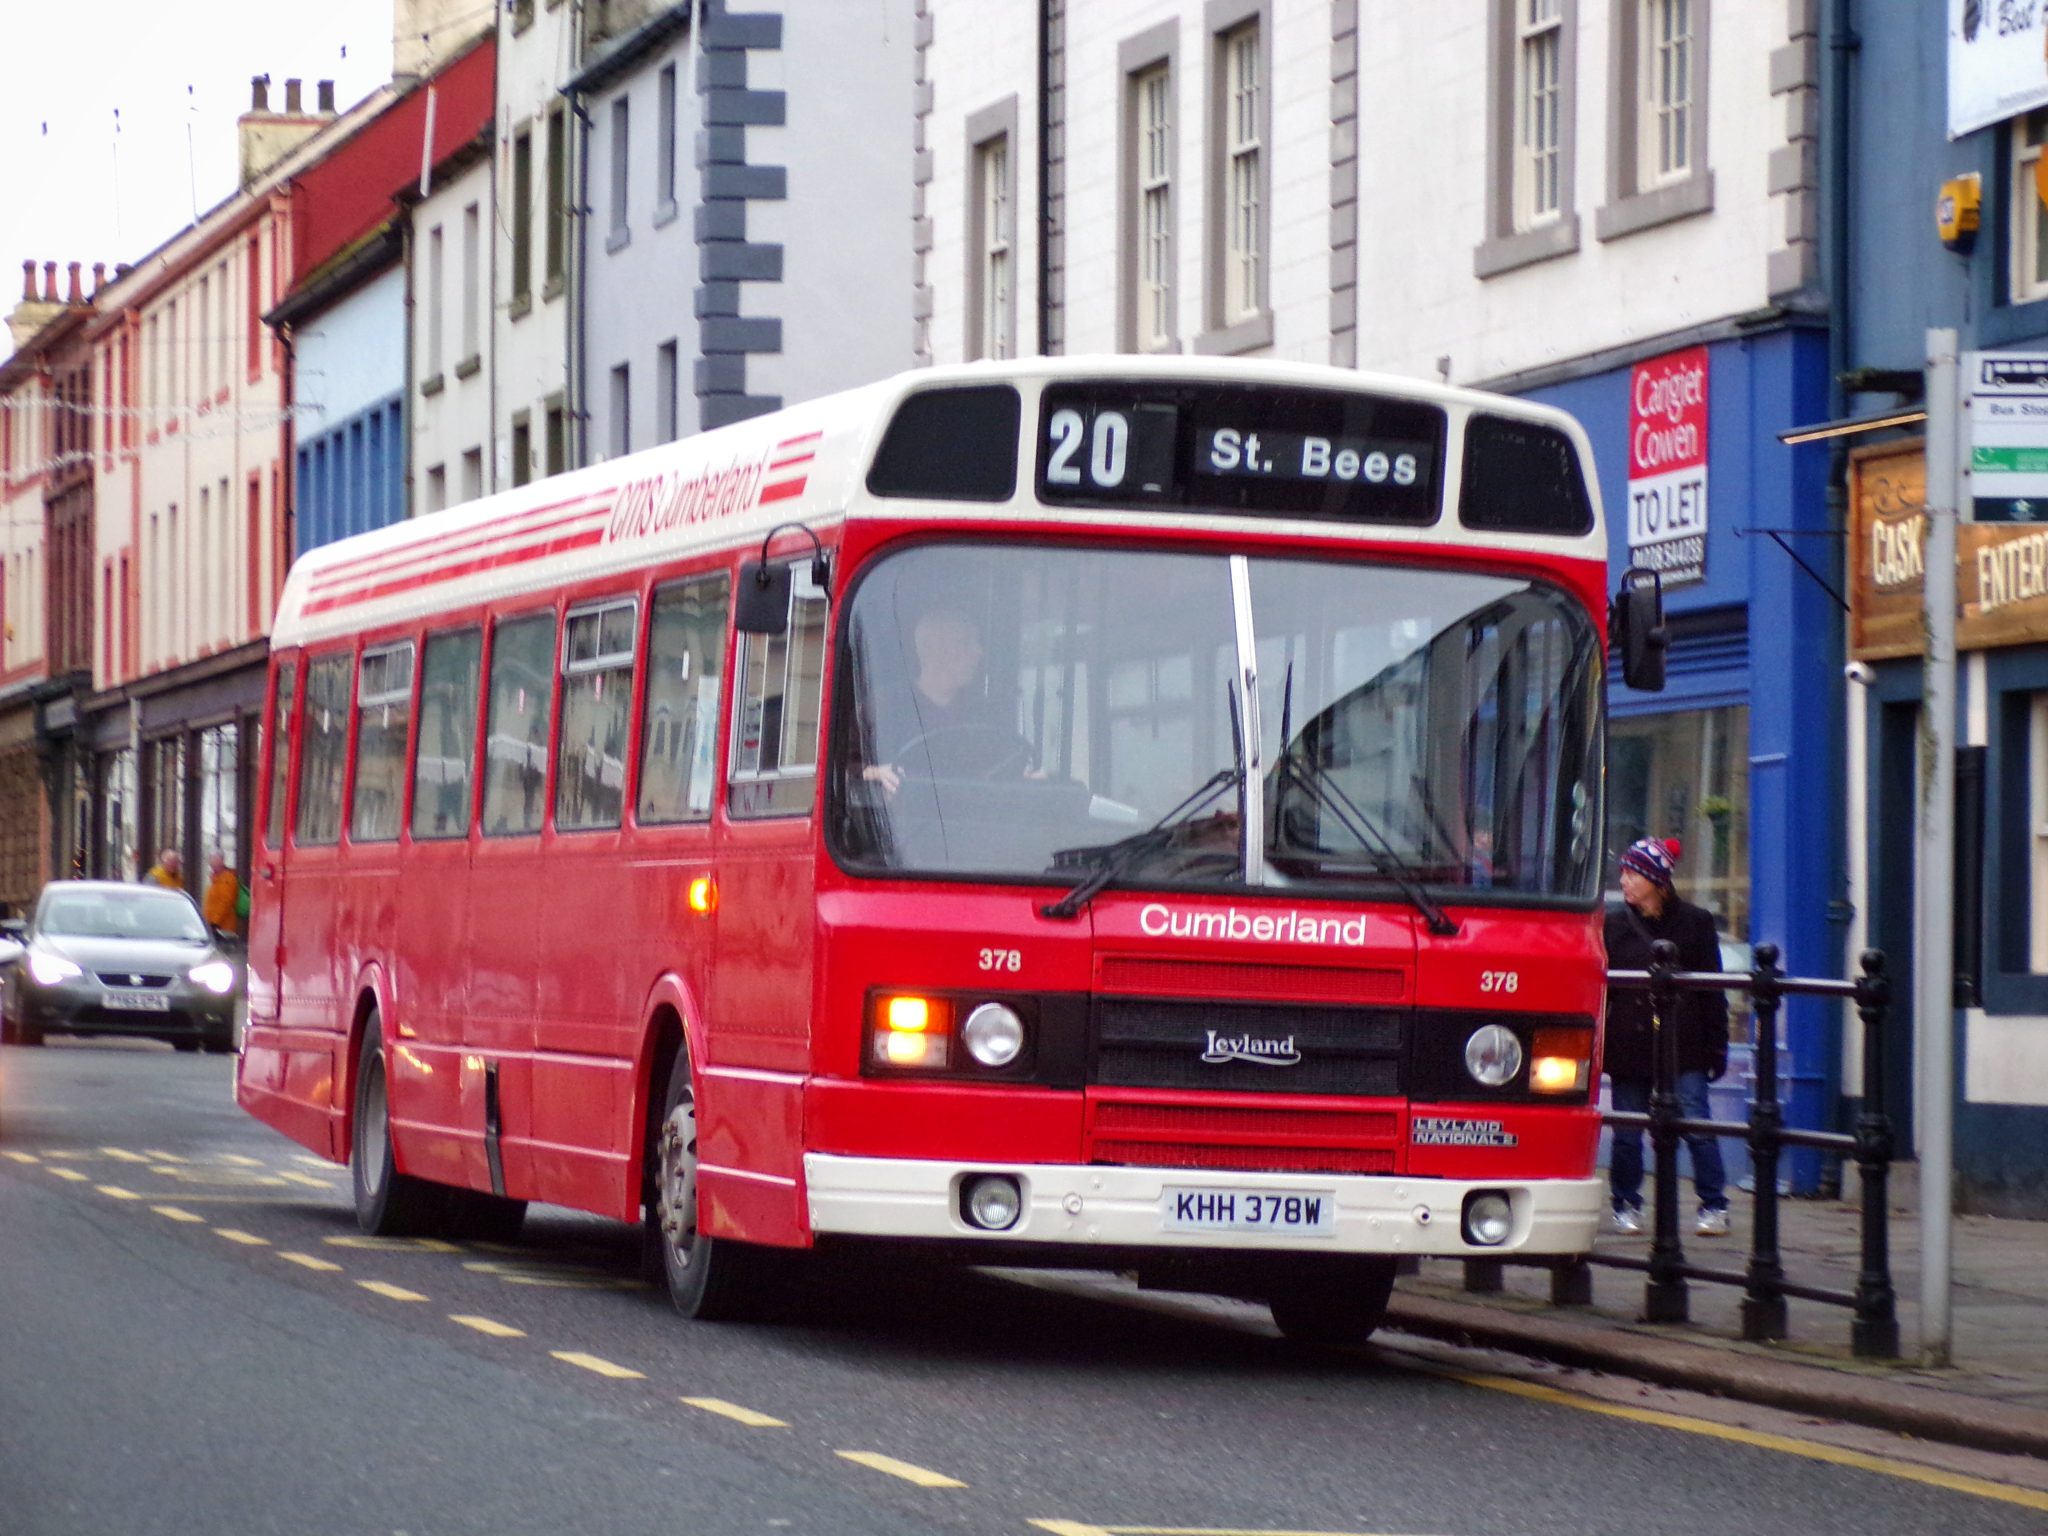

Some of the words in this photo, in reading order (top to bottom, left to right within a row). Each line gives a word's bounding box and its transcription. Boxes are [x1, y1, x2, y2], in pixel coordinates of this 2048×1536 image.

[1635, 362, 1703, 423] Carigiet
[1991, 403, 2014, 414] Bus
[1047, 408, 1128, 488] 20
[1211, 427, 1273, 473] St.
[1302, 436, 1417, 485] Bees
[1634, 421, 1698, 469] Cowen
[1633, 487, 1660, 536] TO
[1666, 481, 1701, 528] LET
[1873, 514, 1924, 585] CASK
[1140, 903, 1366, 946] Cumberland
[979, 947, 1021, 972] 378
[1480, 969, 1518, 993] 378
[1202, 1029, 1301, 1065] Leyland
[1415, 1118, 1500, 1133] LEYLAND
[1415, 1132, 1498, 1146] NATIONAL
[1177, 1193, 1235, 1222] KHH
[1245, 1196, 1321, 1225] 378W
